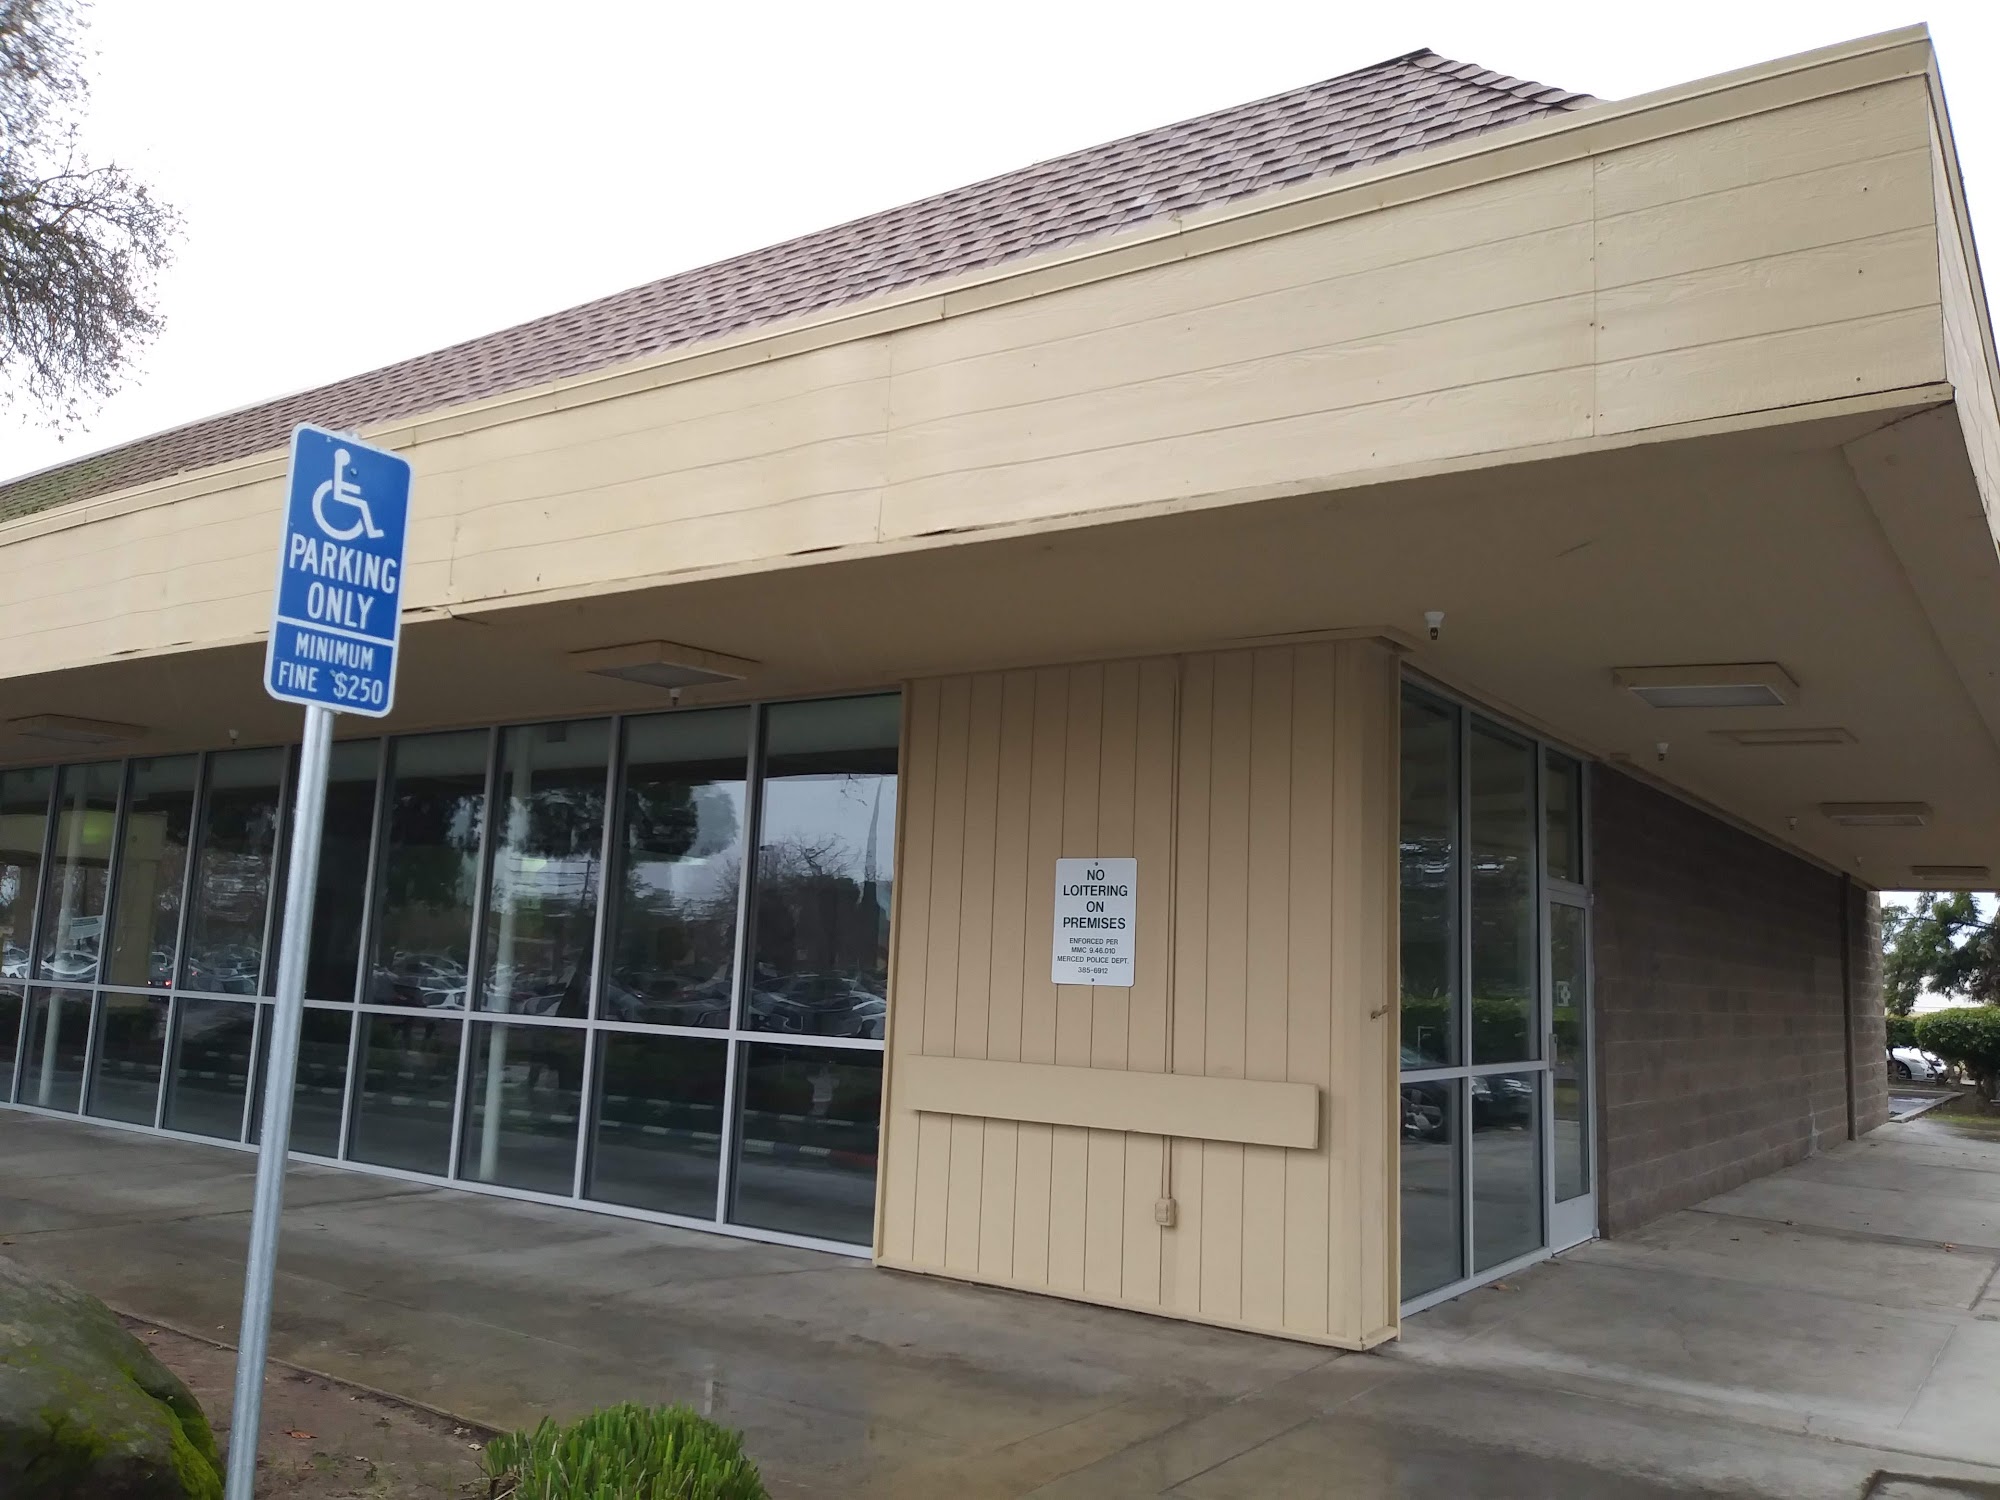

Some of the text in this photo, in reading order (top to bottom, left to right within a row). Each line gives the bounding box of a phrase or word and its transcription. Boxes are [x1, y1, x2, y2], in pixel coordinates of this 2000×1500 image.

[289, 532, 397, 594] PARKING
[307, 582, 374, 629] ONLY
[295, 632, 374, 671] MINIMUM
[278, 661, 383, 704] FINE $250
[1087, 869, 1105, 881] NO
[1063, 885, 1128, 896] LOITERING
[1086, 901, 1104, 912] ON
[1063, 917, 1126, 929] PREMISES
[1071, 946, 1087, 954] MMC
[1057, 955, 1084, 963] MERCED
